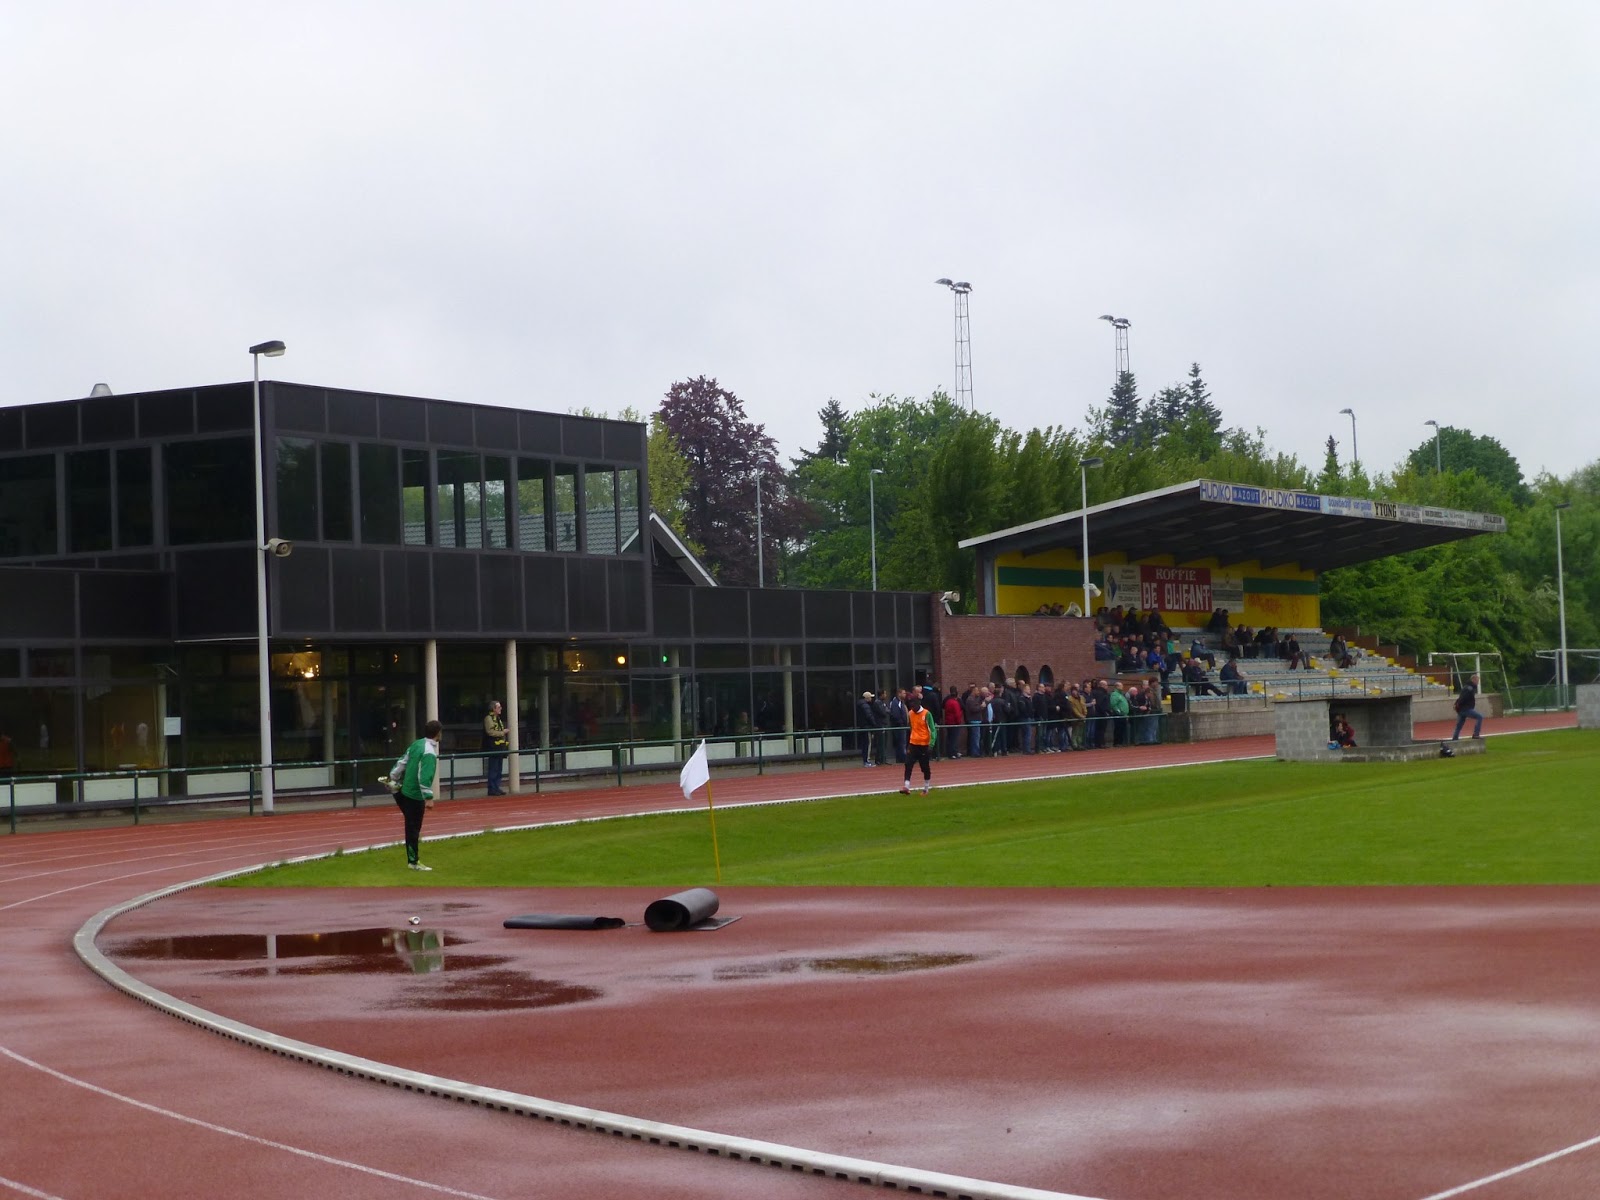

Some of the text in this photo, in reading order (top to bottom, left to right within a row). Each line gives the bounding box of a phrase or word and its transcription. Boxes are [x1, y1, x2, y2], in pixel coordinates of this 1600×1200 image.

[1200, 482, 1260, 502] HUDIKO MAZOUT
[1267, 490, 1320, 509] HUDIKO MAZOUT
[1374, 502, 1397, 518] YTONG
[1155, 568, 1196, 581] KOFFIE
[1143, 582, 1211, 611] DE OLIFANT
